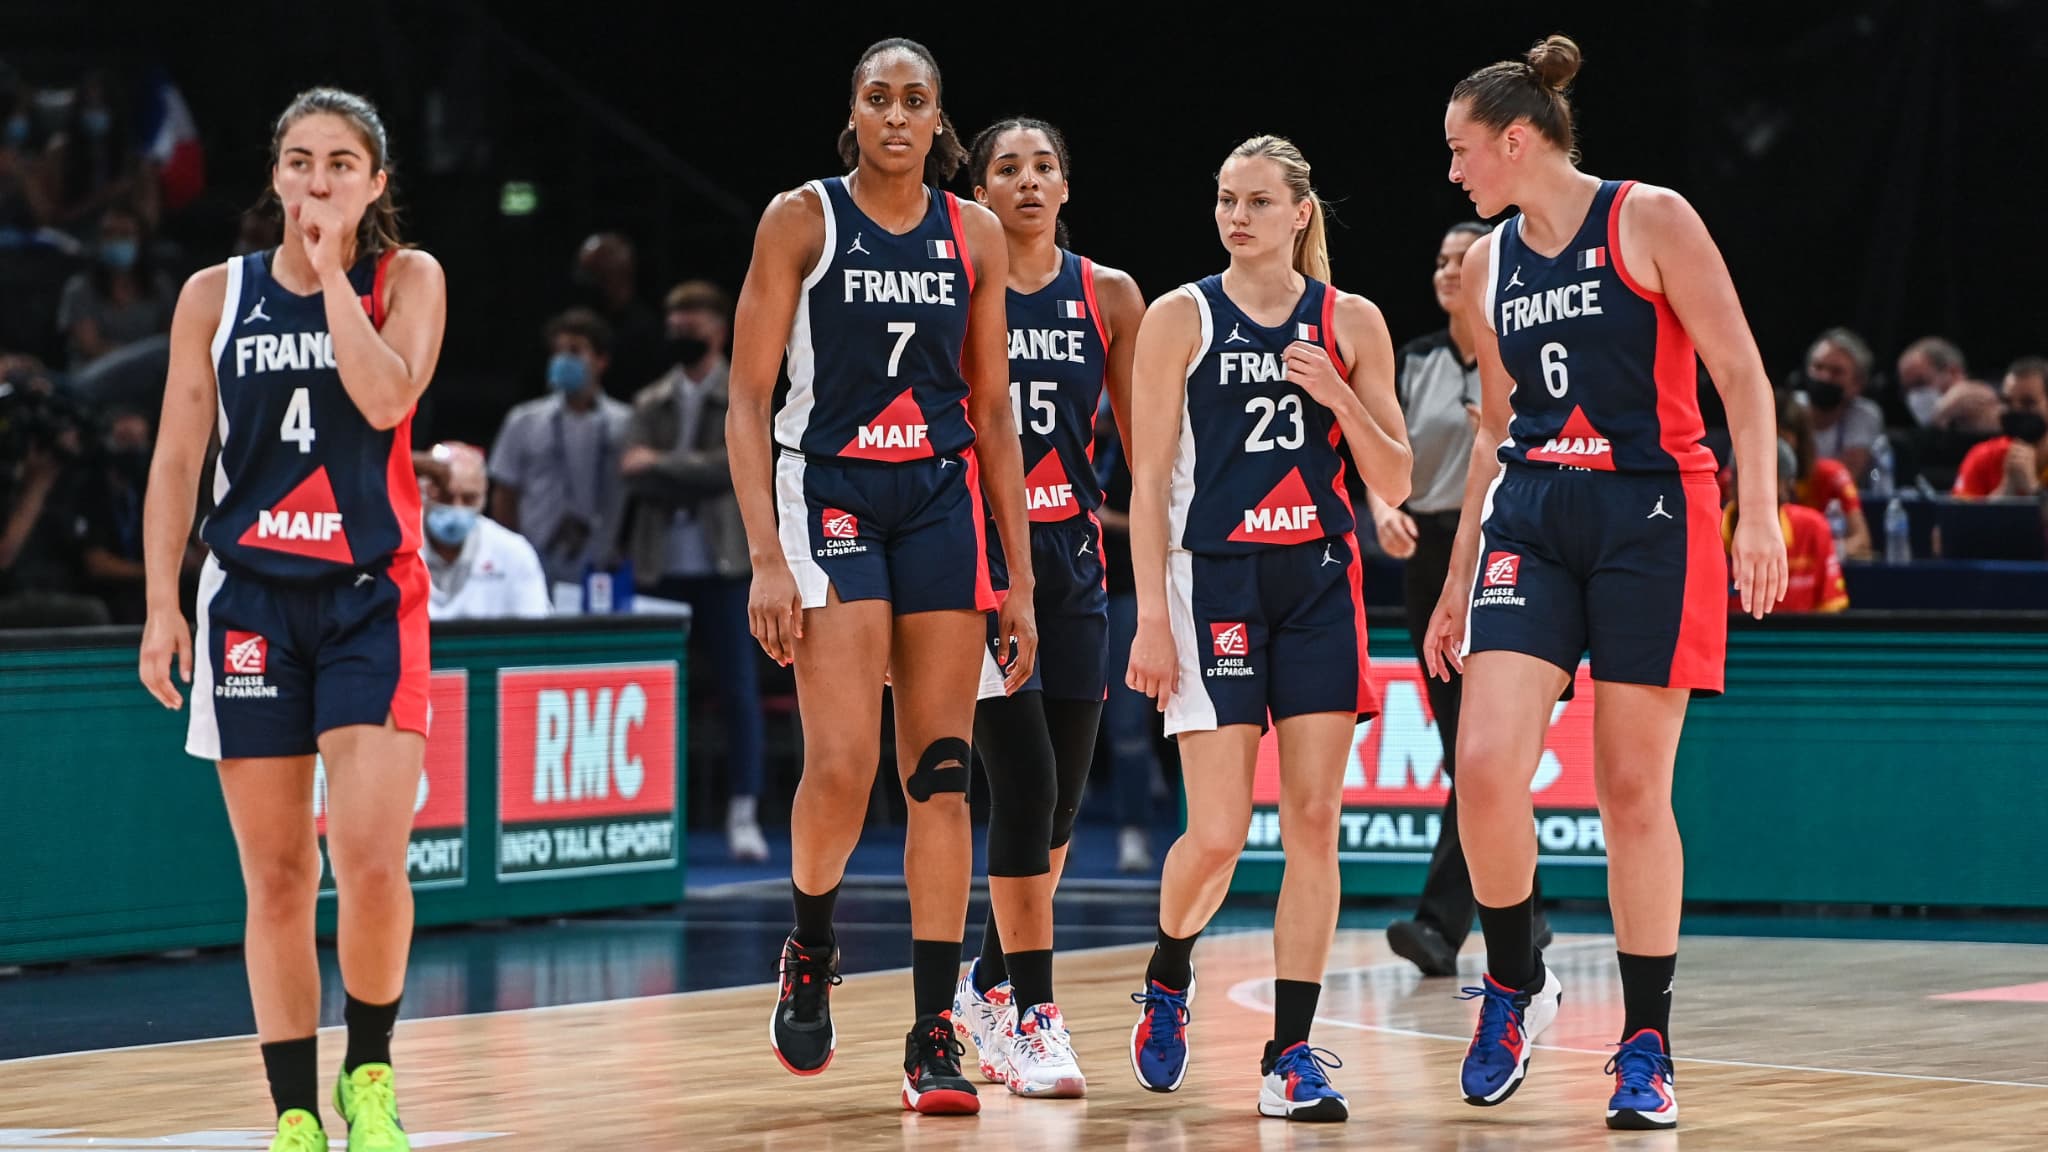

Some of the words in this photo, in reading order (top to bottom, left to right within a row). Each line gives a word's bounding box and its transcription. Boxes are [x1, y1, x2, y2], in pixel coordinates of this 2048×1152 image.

[844, 269, 957, 306] FRANCE
[1501, 280, 1604, 336] FRANCE
[887, 322, 916, 378] 7
[1008, 329, 1085, 364] ANCE
[1540, 342, 1569, 399] 6
[280, 387, 316, 453] 4
[1009, 381, 1058, 436] 15
[1244, 394, 1305, 453] 23
[858, 424, 929, 449] MAIF
[1540, 437, 1611, 456] MAIF
[257, 510, 343, 541] MAIF
[1244, 505, 1318, 533] MAIF
[826, 539, 857, 548] CAISSE
[1482, 588, 1515, 597] CAISSE
[1216, 658, 1244, 667] CAISSE
[225, 675, 265, 686] CAISSE
[532, 682, 648, 804] RMC
[406, 838, 464, 873] PORT
[501, 829, 552, 865] INFO
[553, 825, 604, 862] TALK
[605, 820, 674, 859] SPORT
